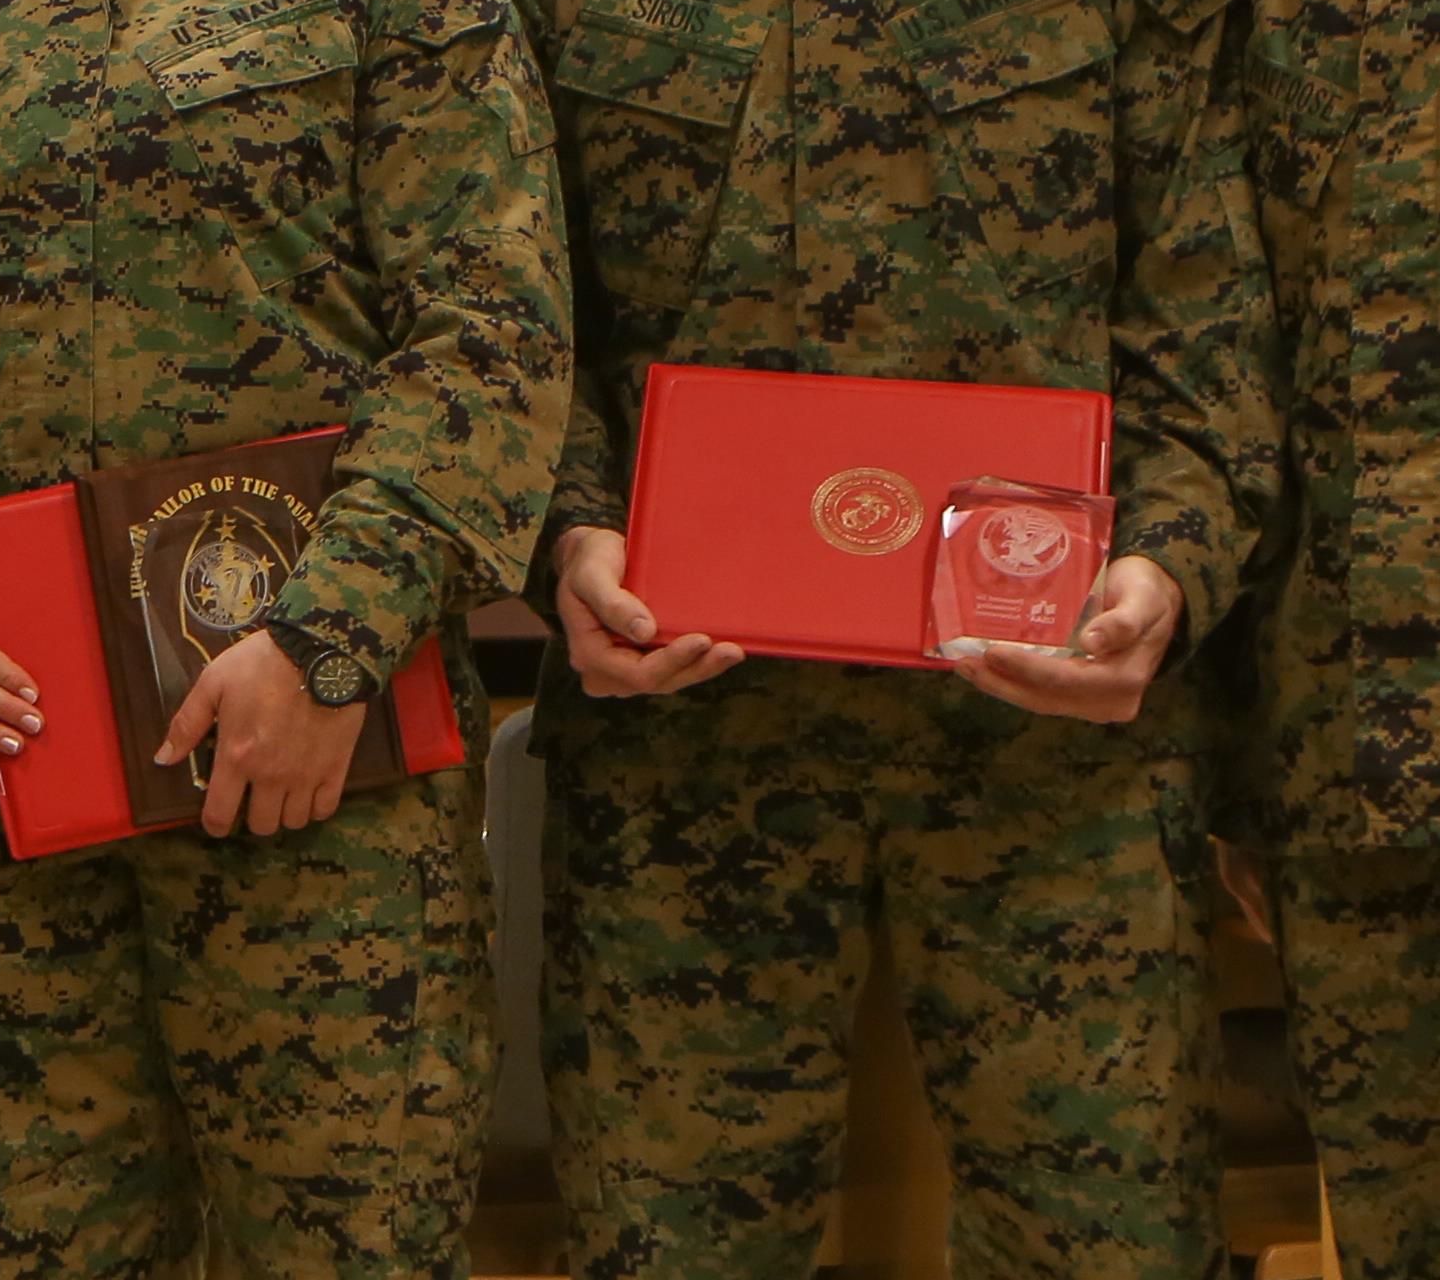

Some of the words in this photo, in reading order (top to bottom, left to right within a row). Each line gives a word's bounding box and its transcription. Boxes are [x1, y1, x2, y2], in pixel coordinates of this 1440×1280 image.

[170, 19, 223, 46] U.S.
[899, 4, 956, 42] U.S.
[150, 482, 207, 523] AILOR
[210, 475, 235, 493] OF
[241, 476, 280, 501] THE
